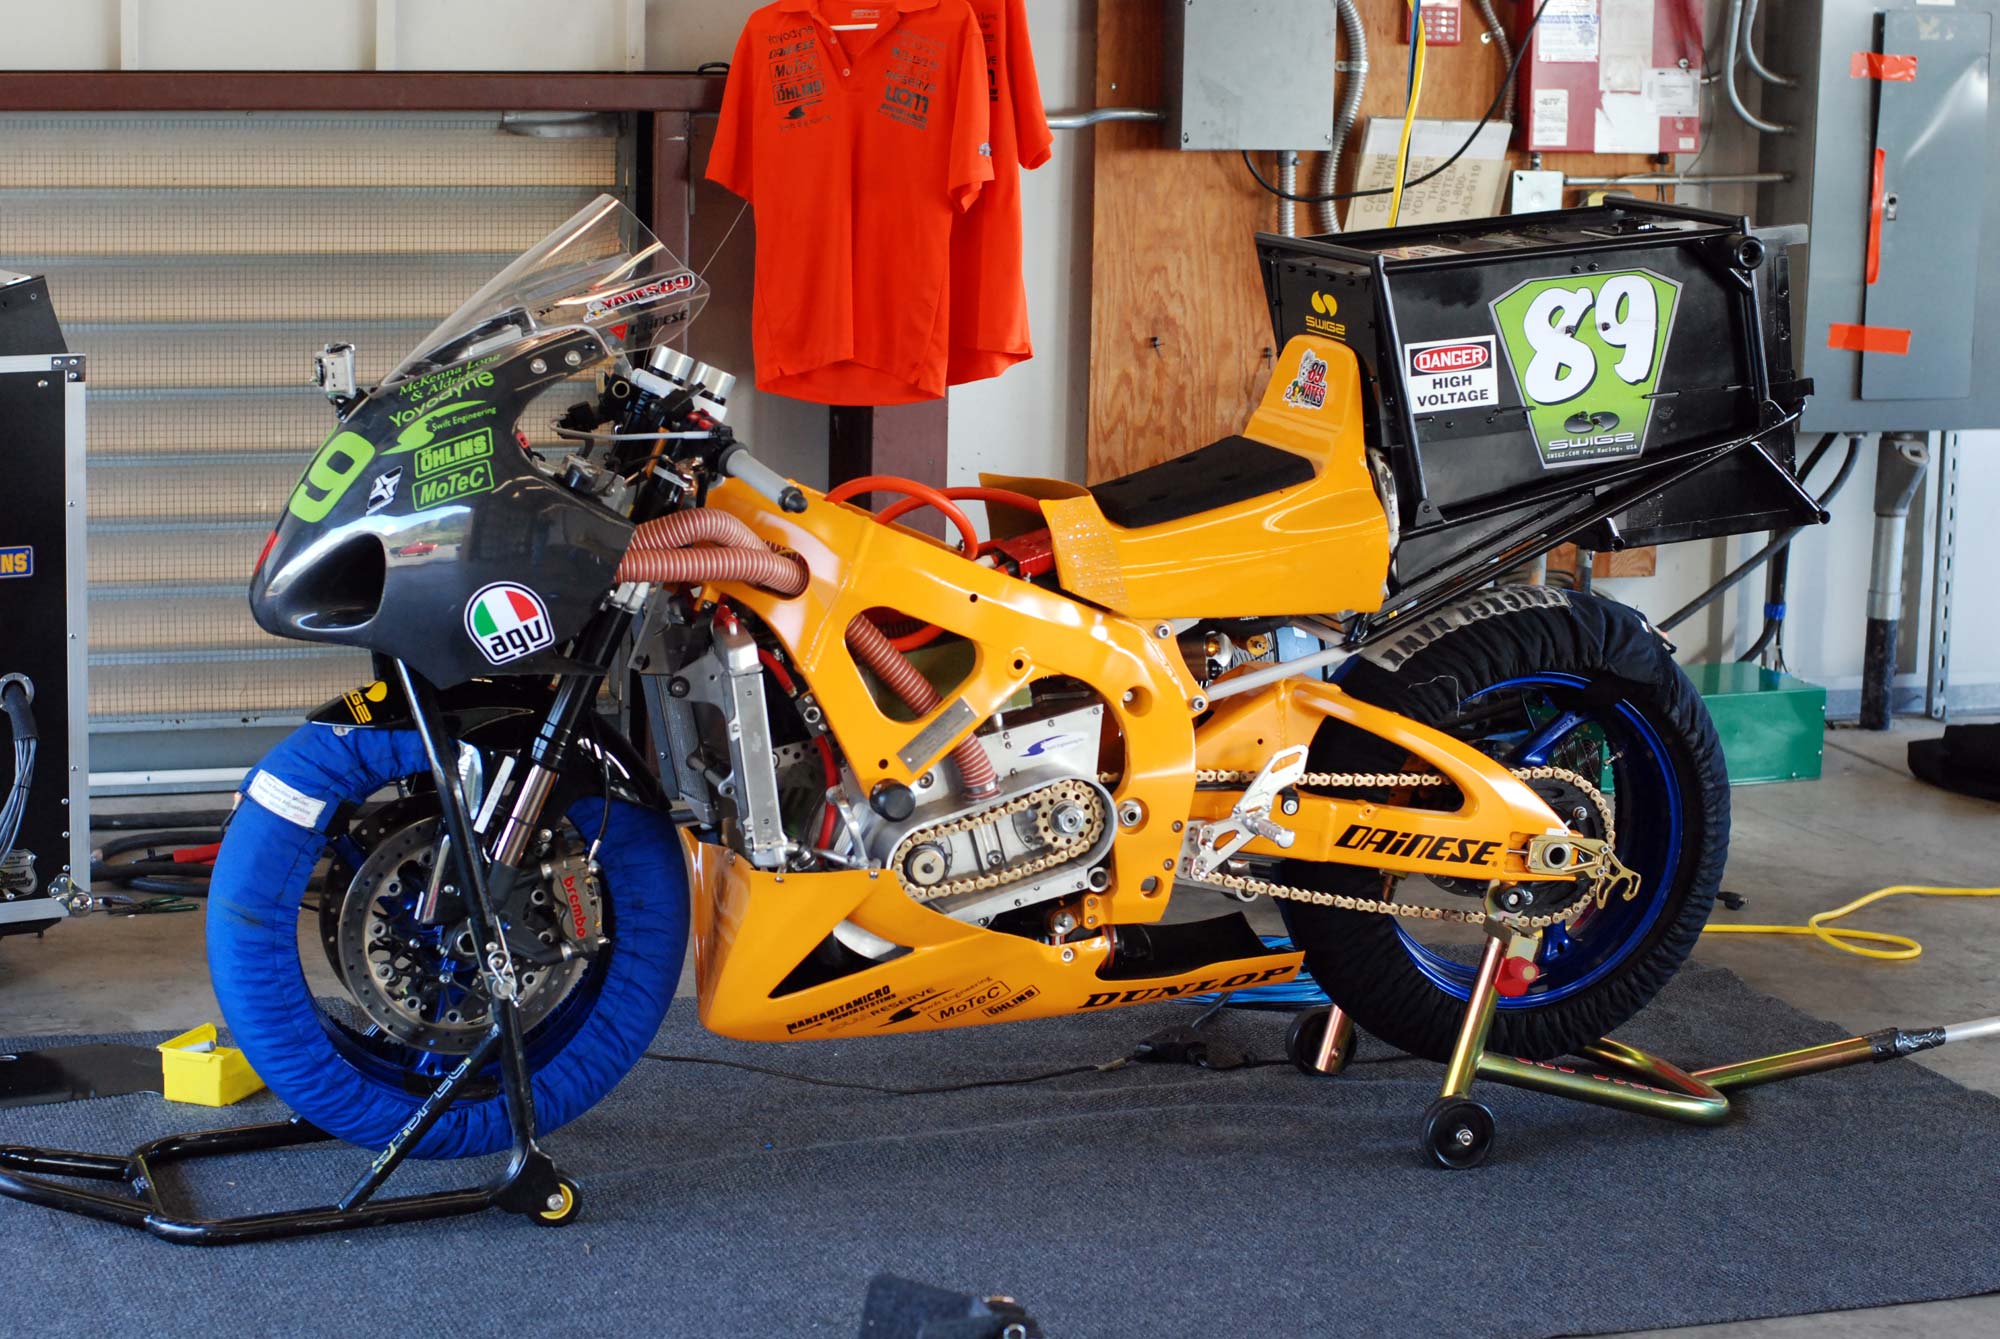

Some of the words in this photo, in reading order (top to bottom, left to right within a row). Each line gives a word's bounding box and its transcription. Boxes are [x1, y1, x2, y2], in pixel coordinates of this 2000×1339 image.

[602, 285, 661, 310] YATES
[659, 275, 691, 295] 89
[1523, 274, 1657, 406] 89
[1419, 348, 1484, 370] DANGER
[400, 366, 463, 396] McKenna
[410, 390, 424, 402] &
[1417, 388, 1489, 407] VOLTAGE
[1432, 374, 1472, 390] HIGH
[389, 371, 495, 428] Yoyodyne
[431, 418, 452, 432] Swift
[452, 407, 497, 425] Engineering
[419, 434, 489, 473] ÖHLINS
[1582, 448, 1595, 456] Pro
[1625, 443, 1638, 451] USA
[419, 466, 486, 504] MoTeC
[489, 618, 546, 659] agv
[562, 875, 586, 939] brembo
[940, 986, 1001, 1020] MoTeC
[1077, 965, 1295, 1009] DUNLOP
